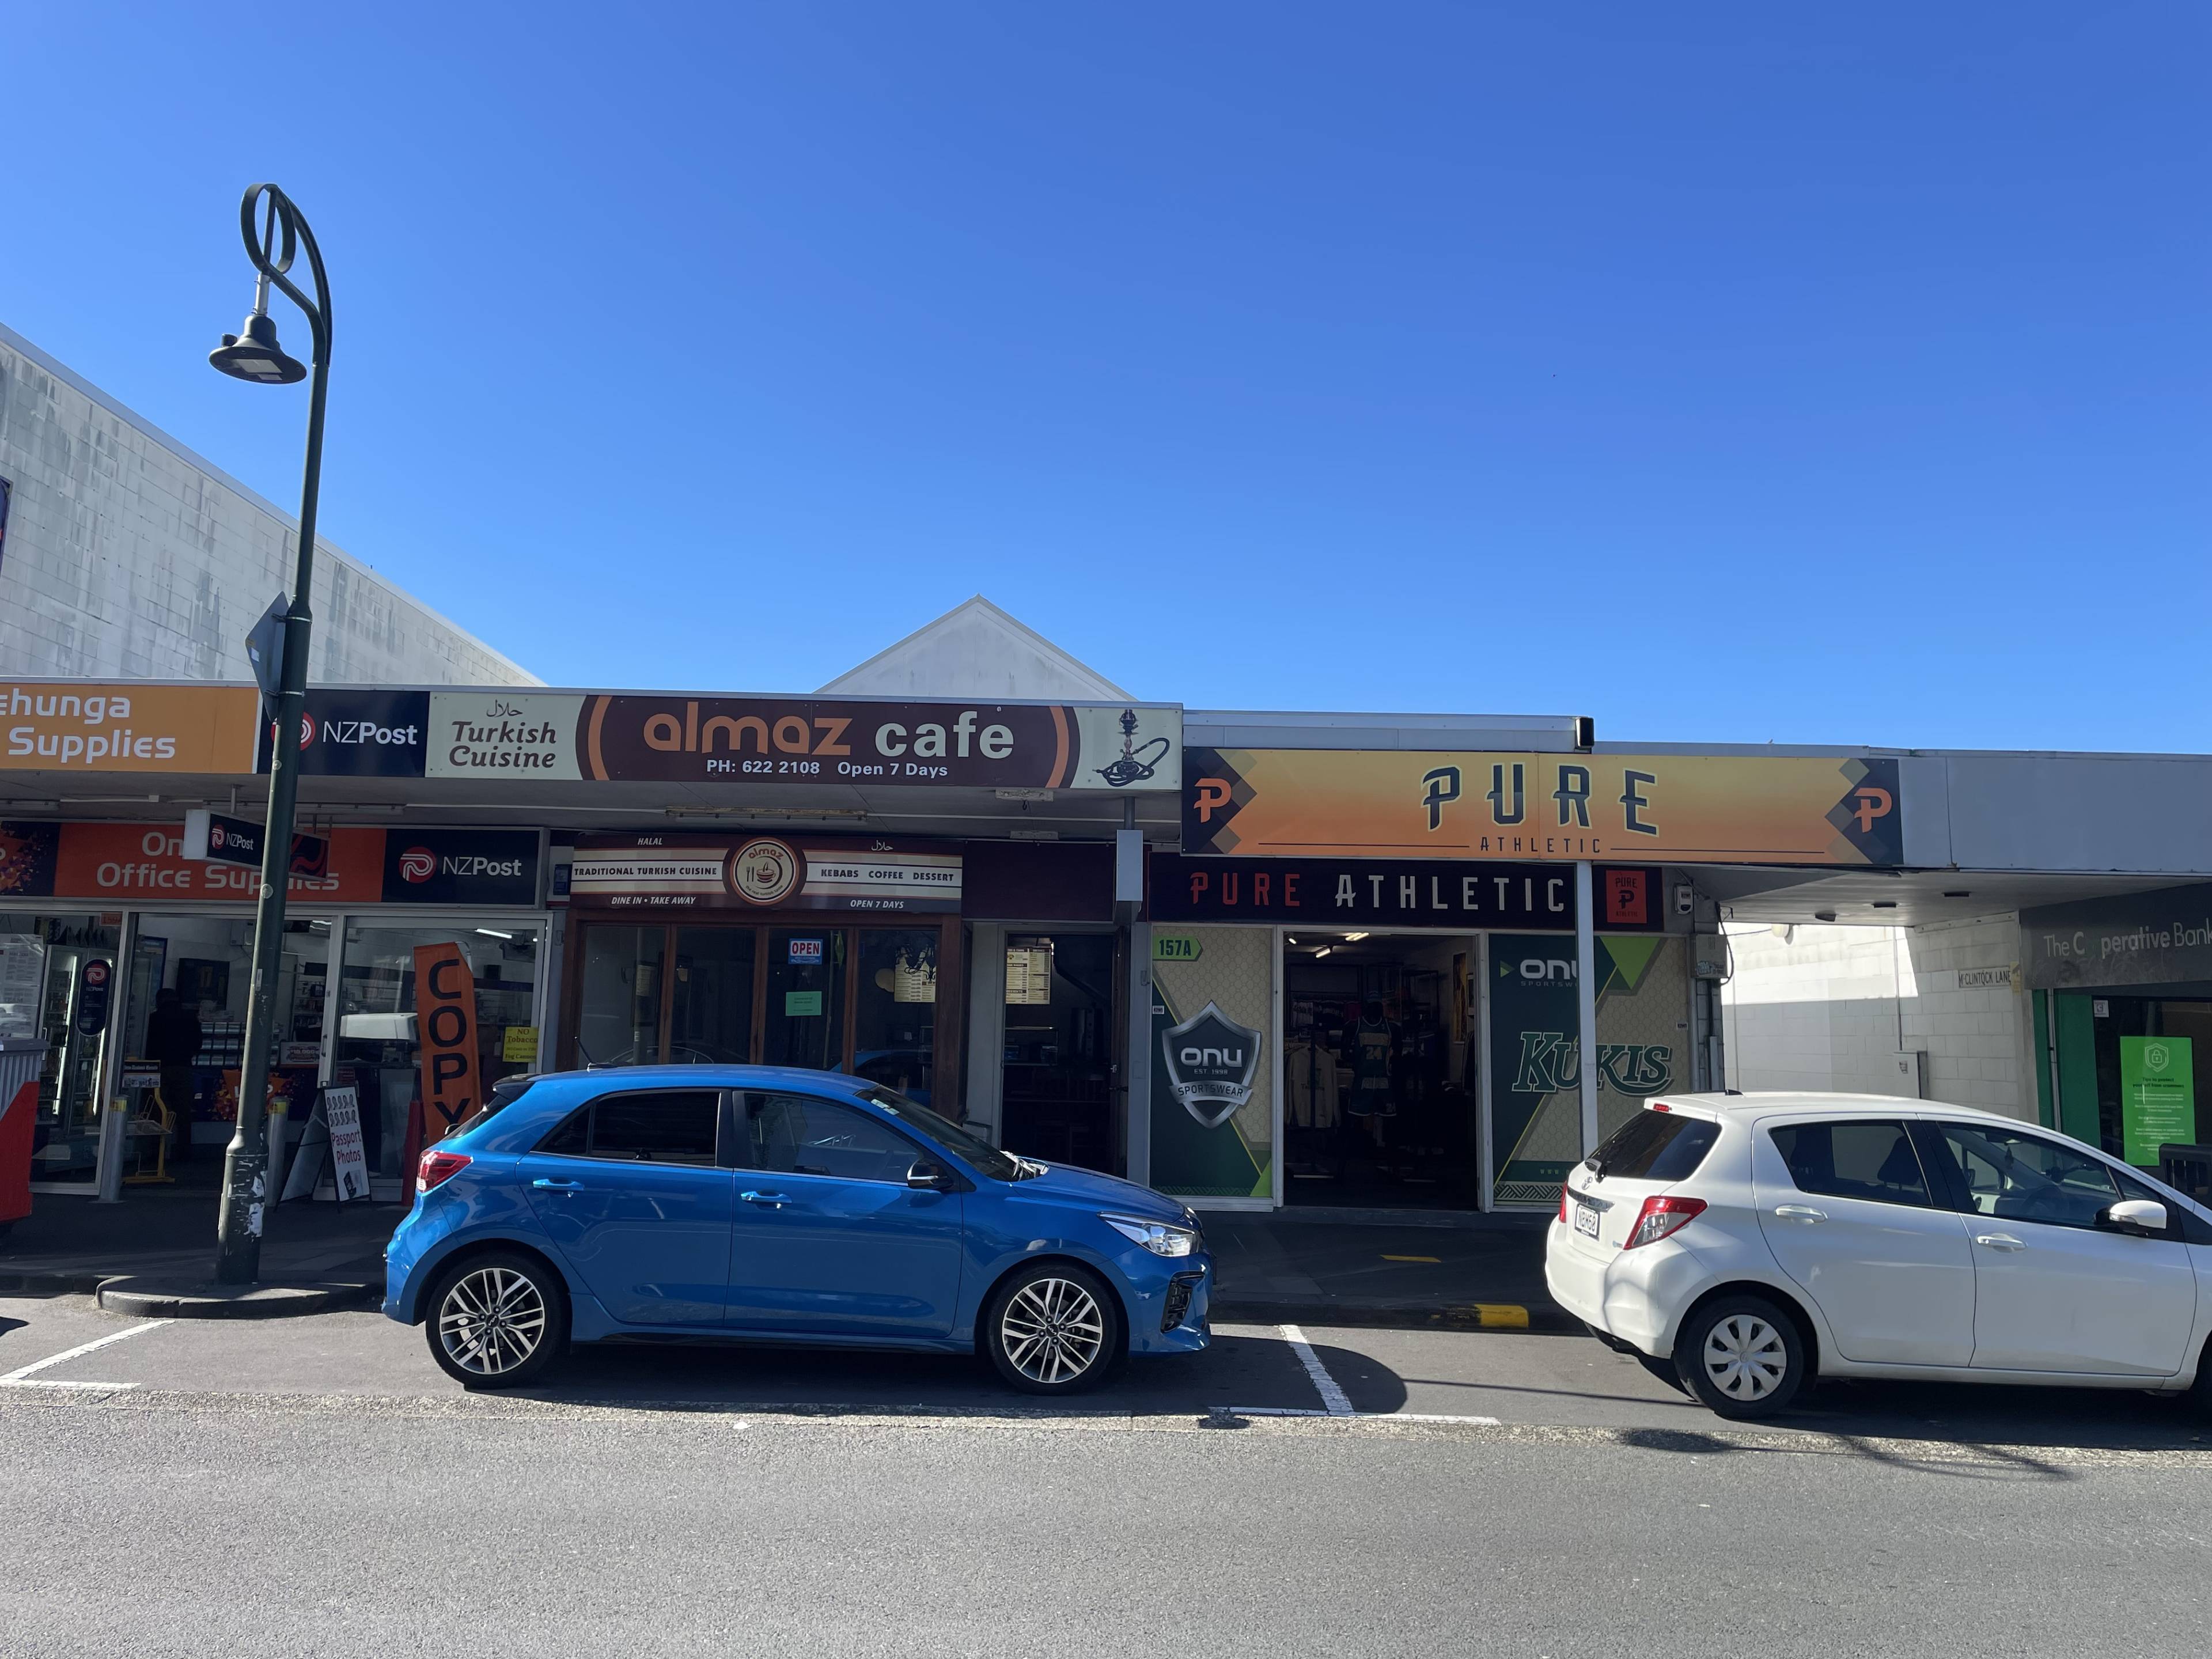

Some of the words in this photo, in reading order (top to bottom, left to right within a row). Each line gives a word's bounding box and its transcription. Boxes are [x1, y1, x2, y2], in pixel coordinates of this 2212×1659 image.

[486, 699, 523, 717] حلال
[323, 721, 418, 745] NZPost
[452, 721, 556, 744] Turkish
[643, 702, 852, 756] almaz
[875, 711, 1014, 759] cafe
[9, 727, 175, 763] Supplies
[449, 745, 556, 768] Cuisine
[707, 759, 736, 773] PH:
[743, 760, 772, 774] 622
[779, 761, 820, 775] 2108
[838, 762, 883, 777] Open
[890, 763, 899, 775] 7
[906, 763, 948, 779] Days
[1421, 762, 1658, 837] PURE
[226, 832, 253, 851] NZPost
[637, 838, 662, 846] HALAL
[1480, 836, 1601, 854] ATHLETIC
[748, 848, 784, 861] almaz
[442, 856, 521, 877] NZPost
[574, 868, 634, 876] TRADITIONAL
[680, 867, 717, 875] CUISINE
[821, 869, 859, 877] KEBABS
[869, 870, 903, 879] COFFEE
[913, 872, 954, 881] DESSERT
[97, 862, 191, 888] Office
[205, 865, 339, 895] Supes
[1615, 877, 1637, 889] PURE
[611, 896, 631, 905] DINE
[650, 897, 670, 905] TAKE
[671, 897, 696, 905] AWAY
[1190, 872, 1301, 907] PURE
[1335, 874, 1565, 912] ATHLETIC
[850, 899, 873, 908] OPEN
[882, 900, 904, 909] DAYS
[2044, 934, 2070, 957] The
[2173, 917, 2212, 947] Bank
[791, 942, 820, 955] OPEN
[1159, 939, 1192, 956] 157A
[1996, 969, 2011, 984] LANE
[428, 959, 471, 1127] COPY
[1177, 1084, 1244, 1097] SPORTSWEAR
[331, 1129, 361, 1148] Passport
[336, 1149, 361, 1165] Photos
